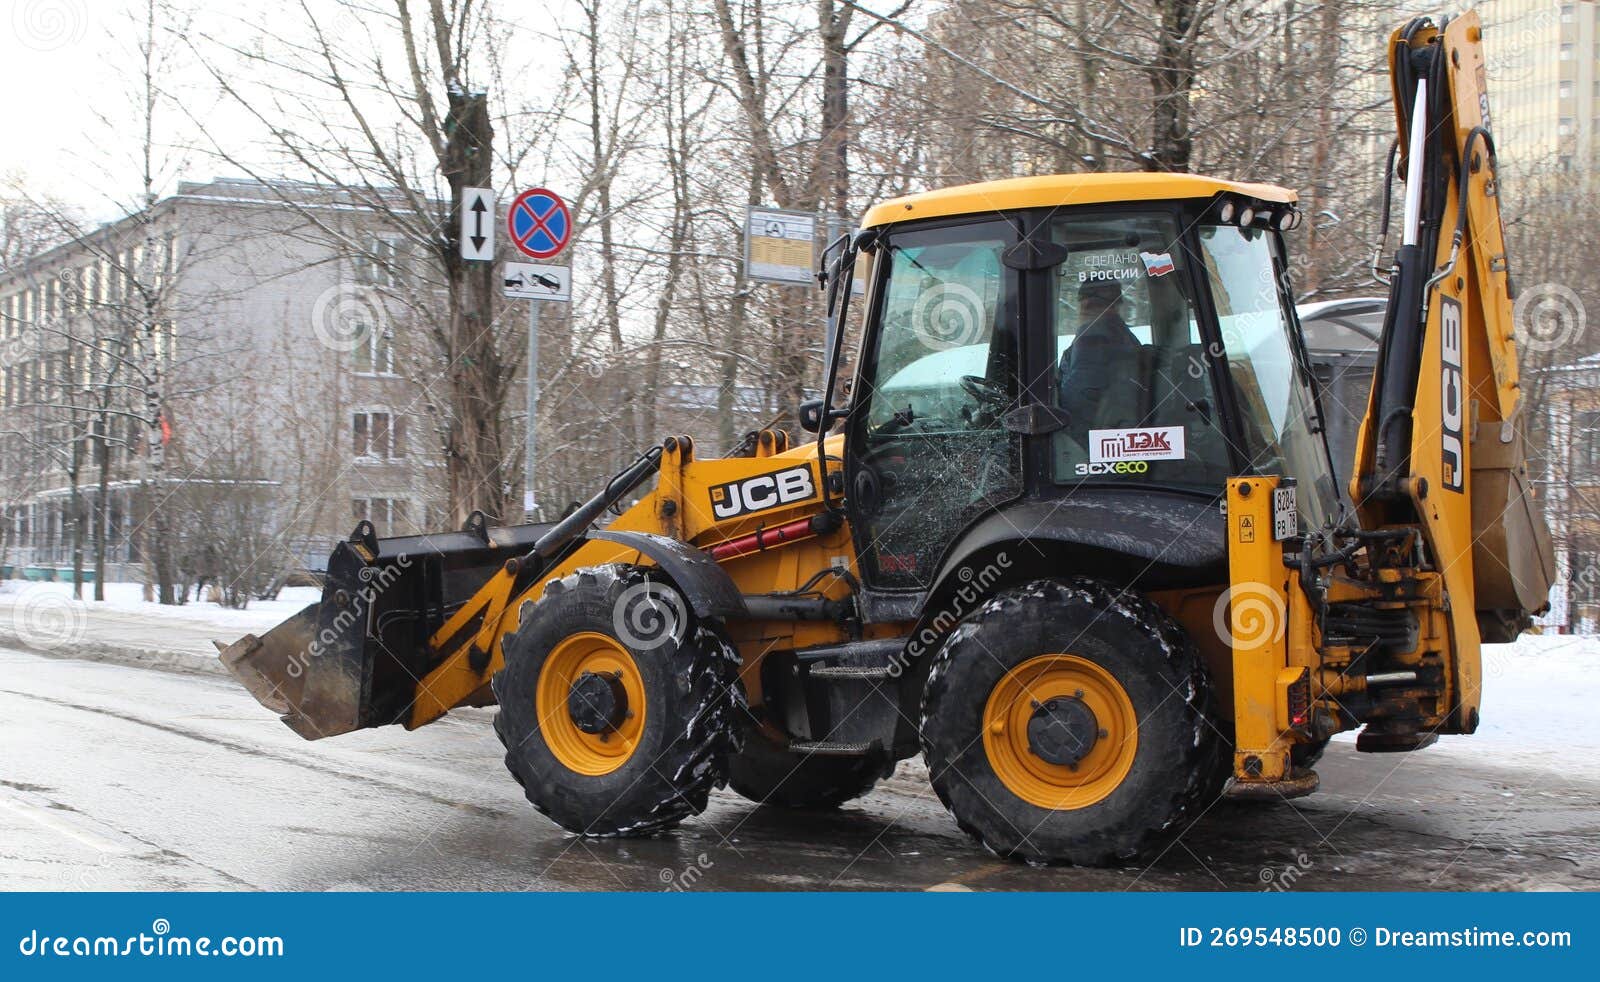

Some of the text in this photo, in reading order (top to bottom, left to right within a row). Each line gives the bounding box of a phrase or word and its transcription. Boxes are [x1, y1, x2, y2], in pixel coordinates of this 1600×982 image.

[1078, 268, 1138, 282] В РОССИИ
[1084, 253, 1138, 266] СДЕЛАНО
[1442, 302, 1462, 488] JCB
[714, 467, 814, 518] JCB
